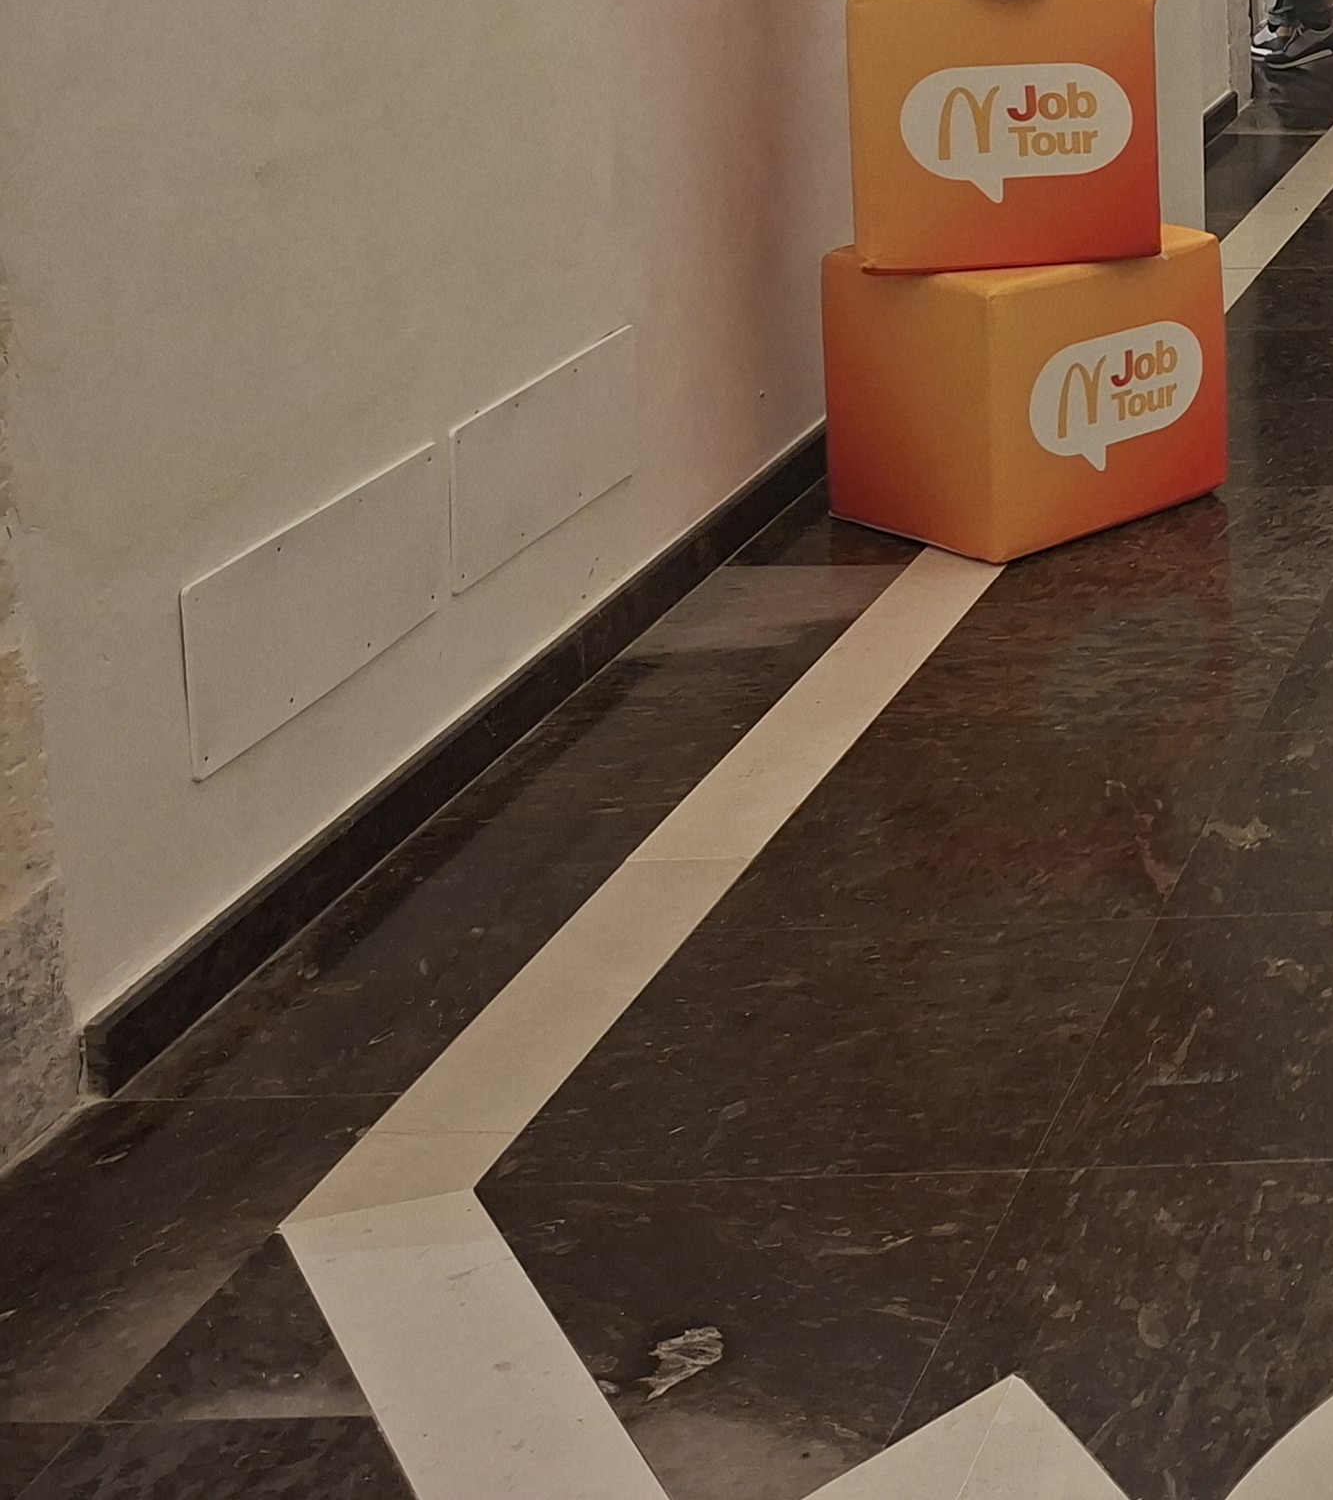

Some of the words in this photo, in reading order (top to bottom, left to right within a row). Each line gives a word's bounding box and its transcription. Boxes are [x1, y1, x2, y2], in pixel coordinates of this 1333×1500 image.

[1006, 82, 1098, 122] Job
[1008, 126, 1099, 157] Tour
[1111, 340, 1178, 387] Job
[1111, 380, 1178, 423] Tour
